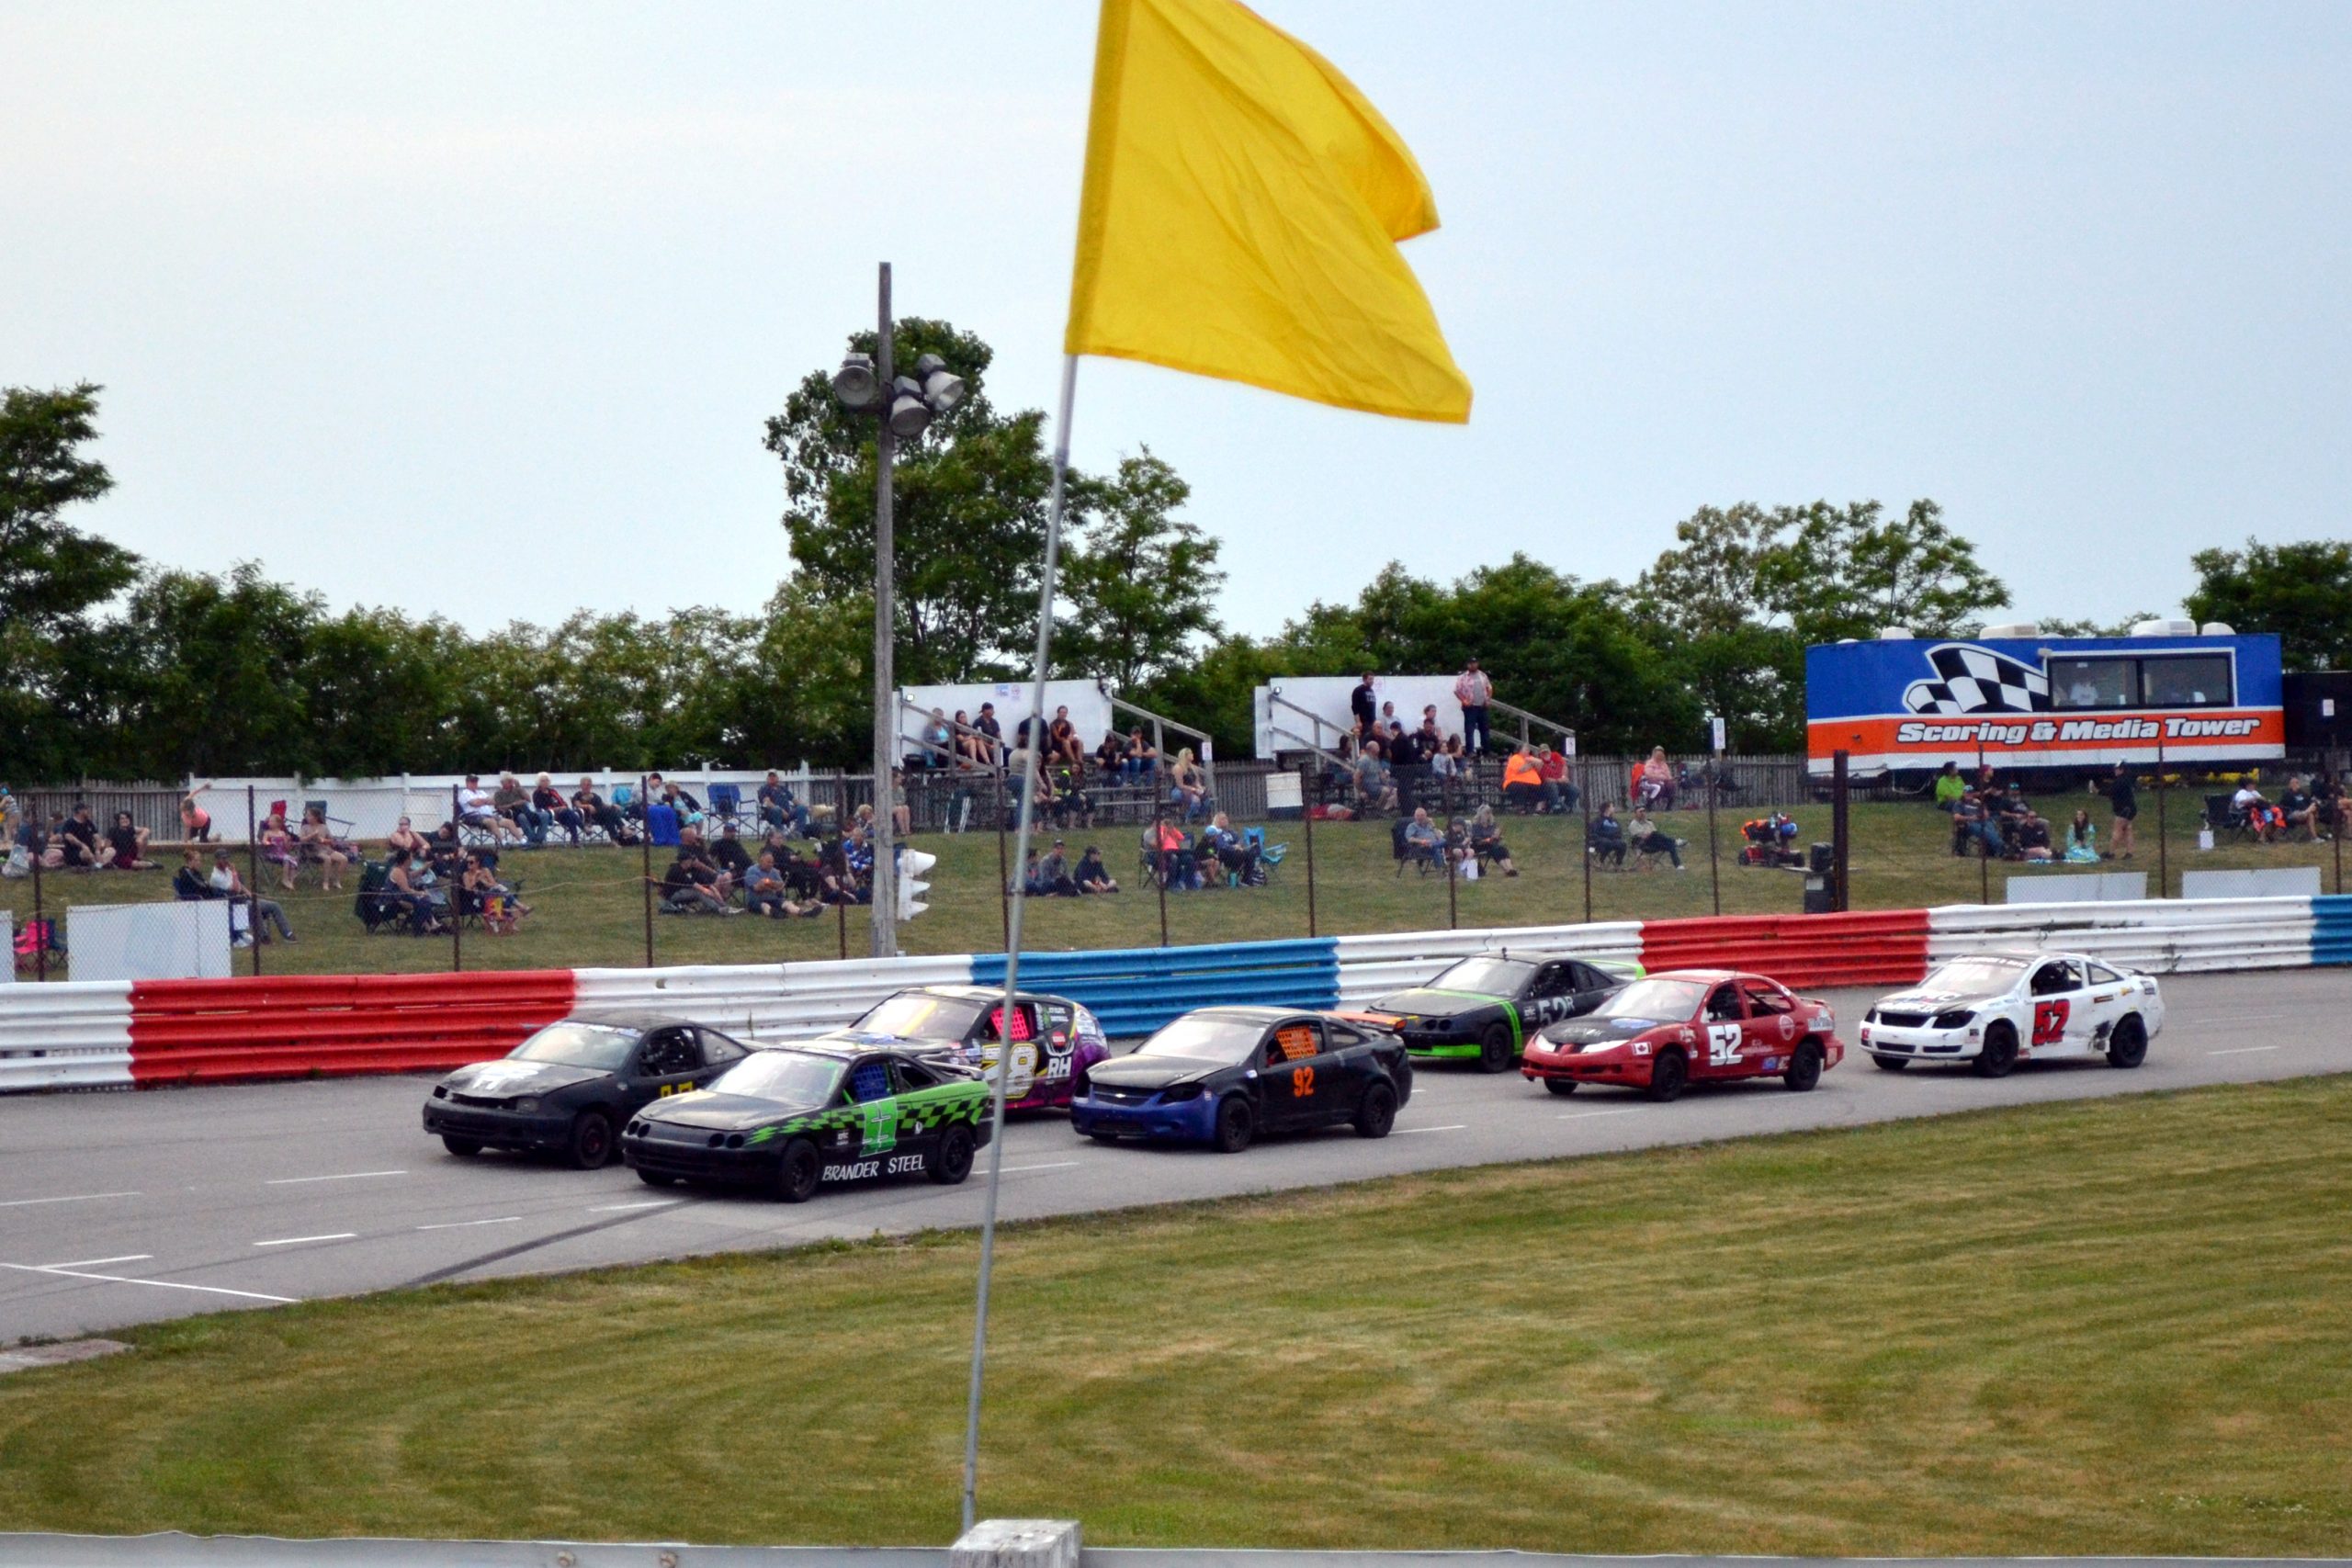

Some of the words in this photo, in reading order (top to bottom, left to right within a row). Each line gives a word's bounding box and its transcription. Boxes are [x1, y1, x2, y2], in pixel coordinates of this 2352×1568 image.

[1896, 721, 2028, 745] Scoring
[2030, 720, 2059, 741] &
[2058, 718, 2160, 741] Media
[2165, 717, 2261, 738] Tower
[2031, 998, 2071, 1047] 52
[1707, 1023, 1744, 1066] 52
[1047, 1056, 1073, 1077] RH
[1293, 1066, 1315, 1098] 92
[821, 1160, 880, 1181] BRANDER
[888, 1154, 925, 1174] STEEL
